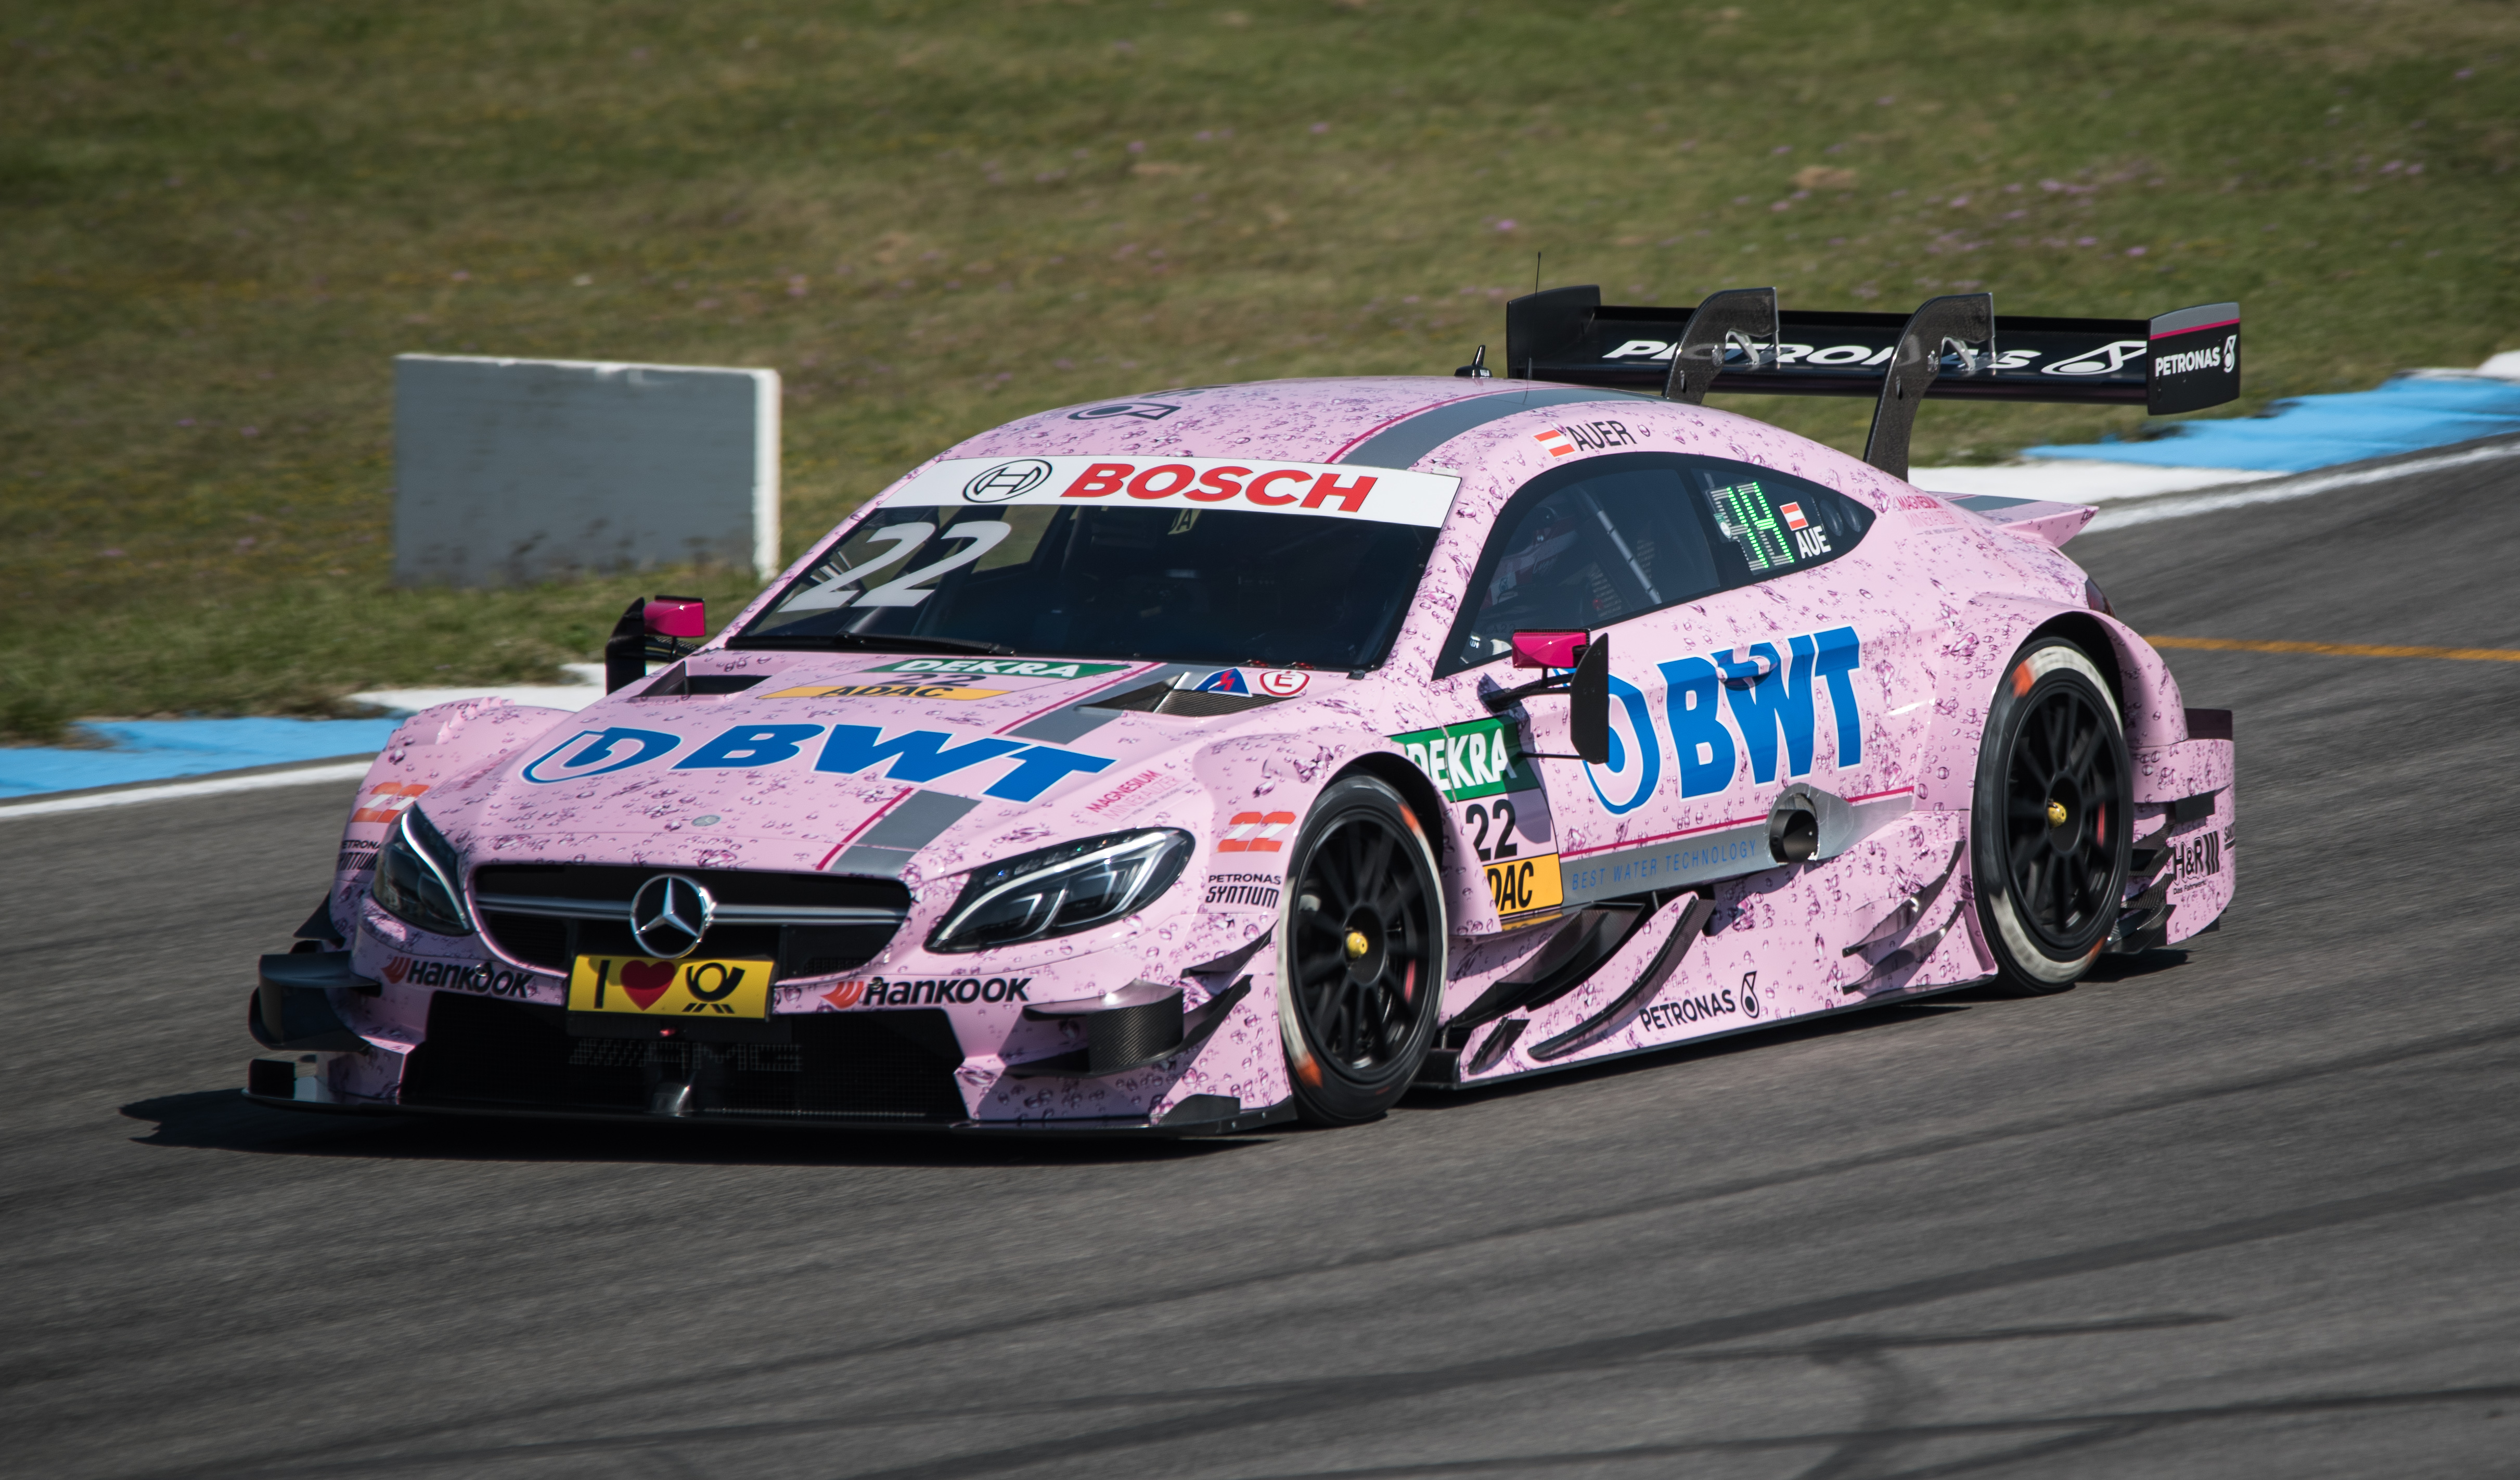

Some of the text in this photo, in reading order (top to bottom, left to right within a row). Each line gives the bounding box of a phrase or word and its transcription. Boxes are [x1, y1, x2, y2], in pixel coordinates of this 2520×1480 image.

[2155, 347, 2220, 377] PETRONAS
[1566, 420, 1637, 451] AUER
[1060, 463, 1378, 512] BOSCH
[1795, 525, 1831, 559] AUE
[778, 521, 1011, 613] 22
[877, 673, 986, 687] 22
[892, 660, 1079, 677] DEKRA
[820, 686, 953, 697] ADAC
[1656, 626, 1862, 800] BWT
[668, 723, 1118, 803] BWT
[1406, 728, 1517, 791] DEKRA
[1085, 770, 1163, 812] MAGNESIUM
[341, 839, 380, 850] ETRON
[1216, 812, 1296, 852] 22
[1466, 799, 1518, 862] 22
[1208, 874, 1281, 885] PETRONAS
[1572, 839, 1756, 890] BEST WATER TECHNOLOGY
[1205, 886, 1280, 910] SYNTIUM
[1487, 861, 1534, 912] DAC
[1639, 989, 1736, 1032] PETRONAS
